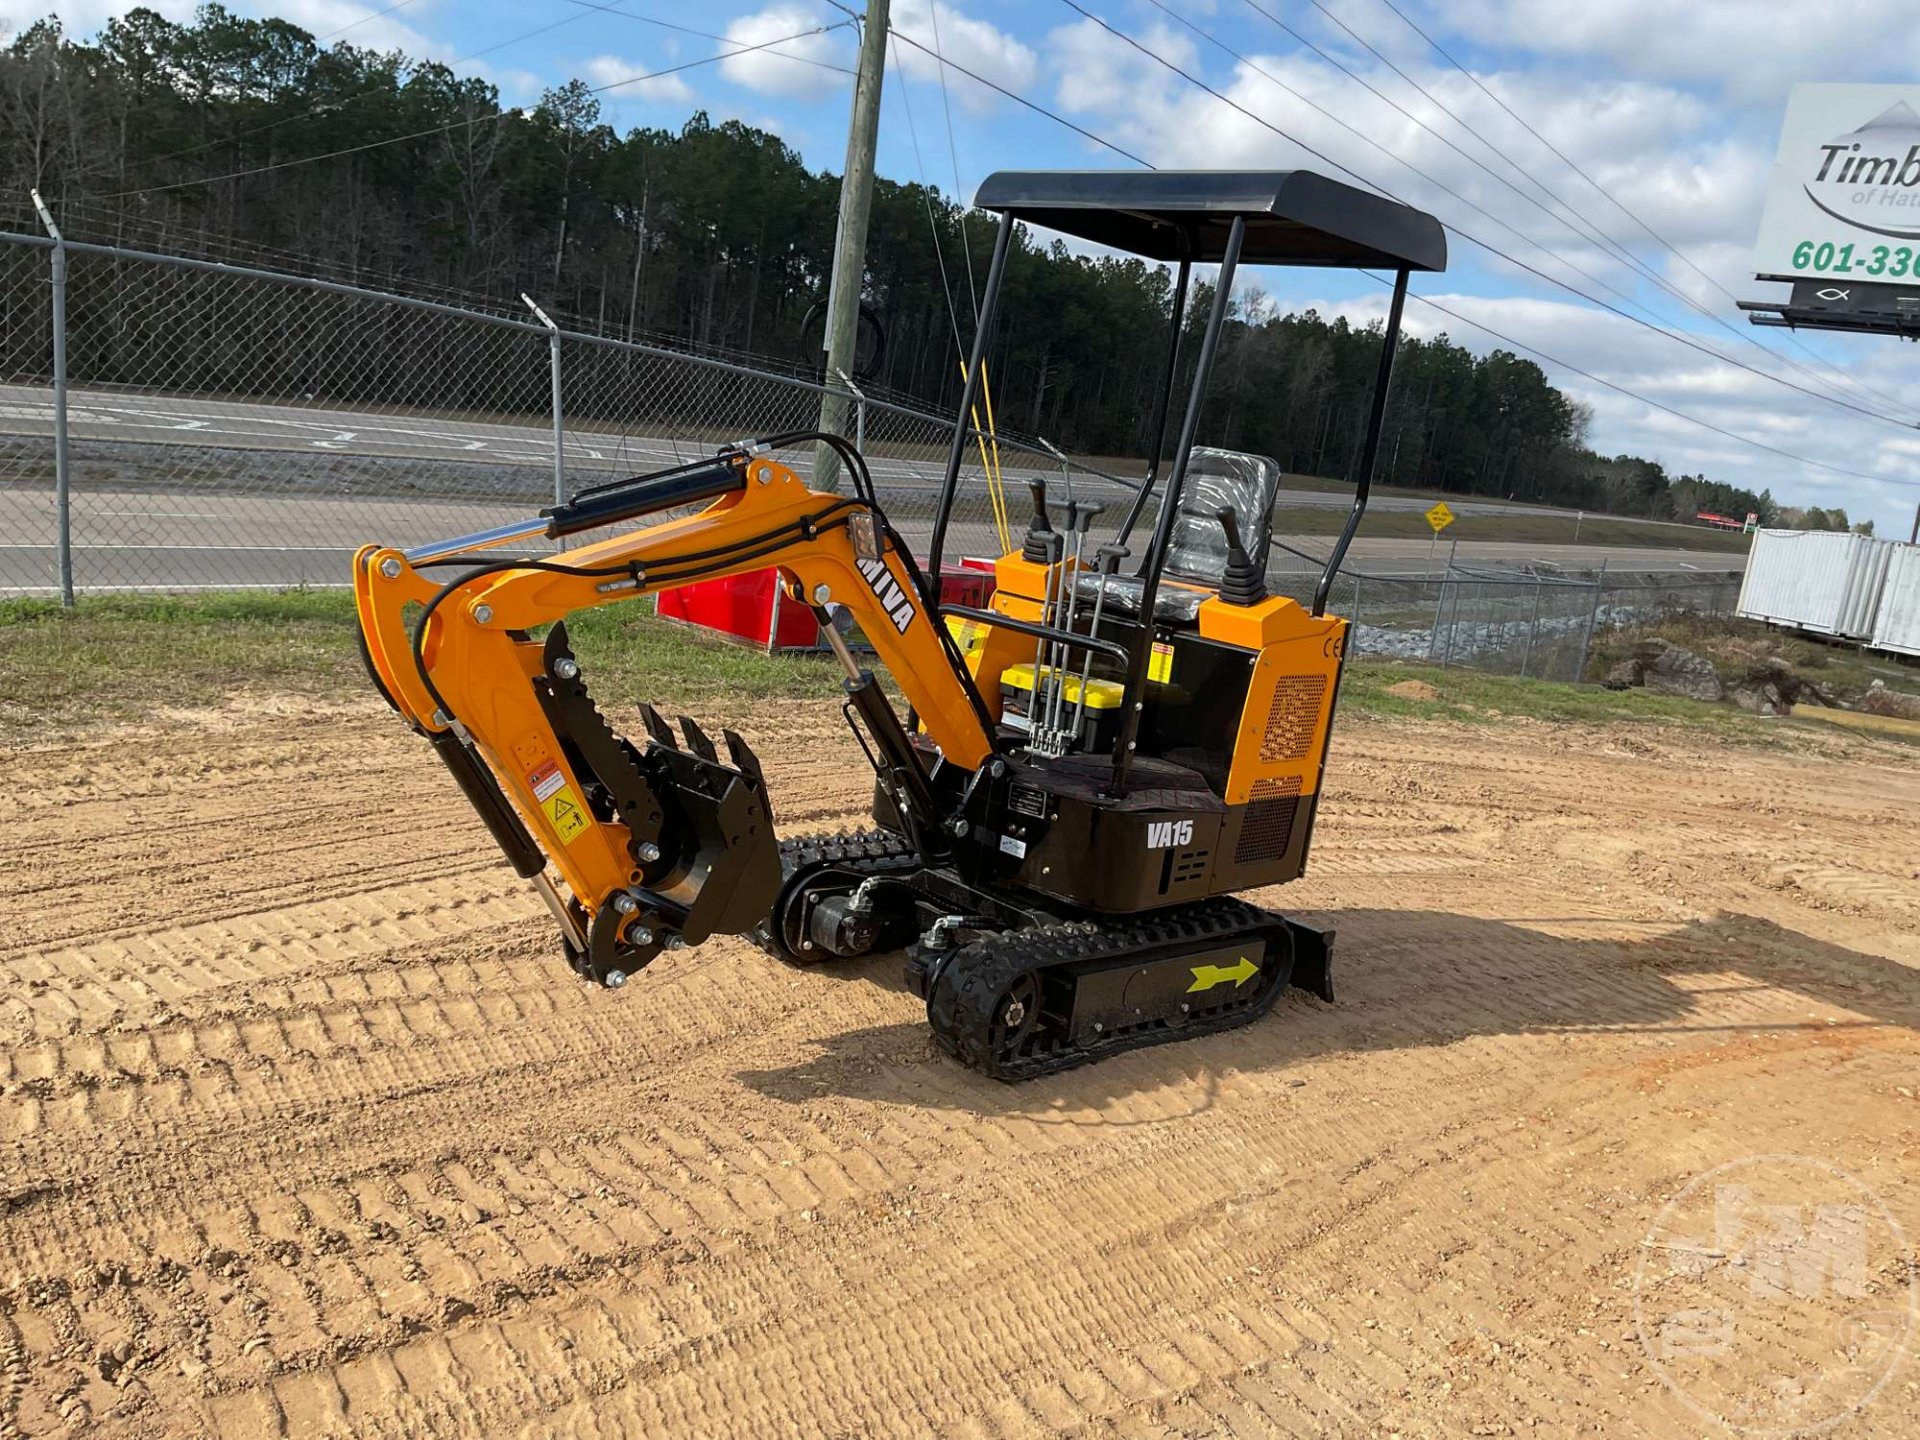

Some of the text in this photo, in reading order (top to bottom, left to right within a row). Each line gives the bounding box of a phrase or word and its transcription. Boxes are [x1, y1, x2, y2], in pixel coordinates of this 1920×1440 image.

[1852, 188, 1920, 207] of Hat
[856, 558, 916, 635] MIVA
[1147, 819, 1194, 849] VA15
